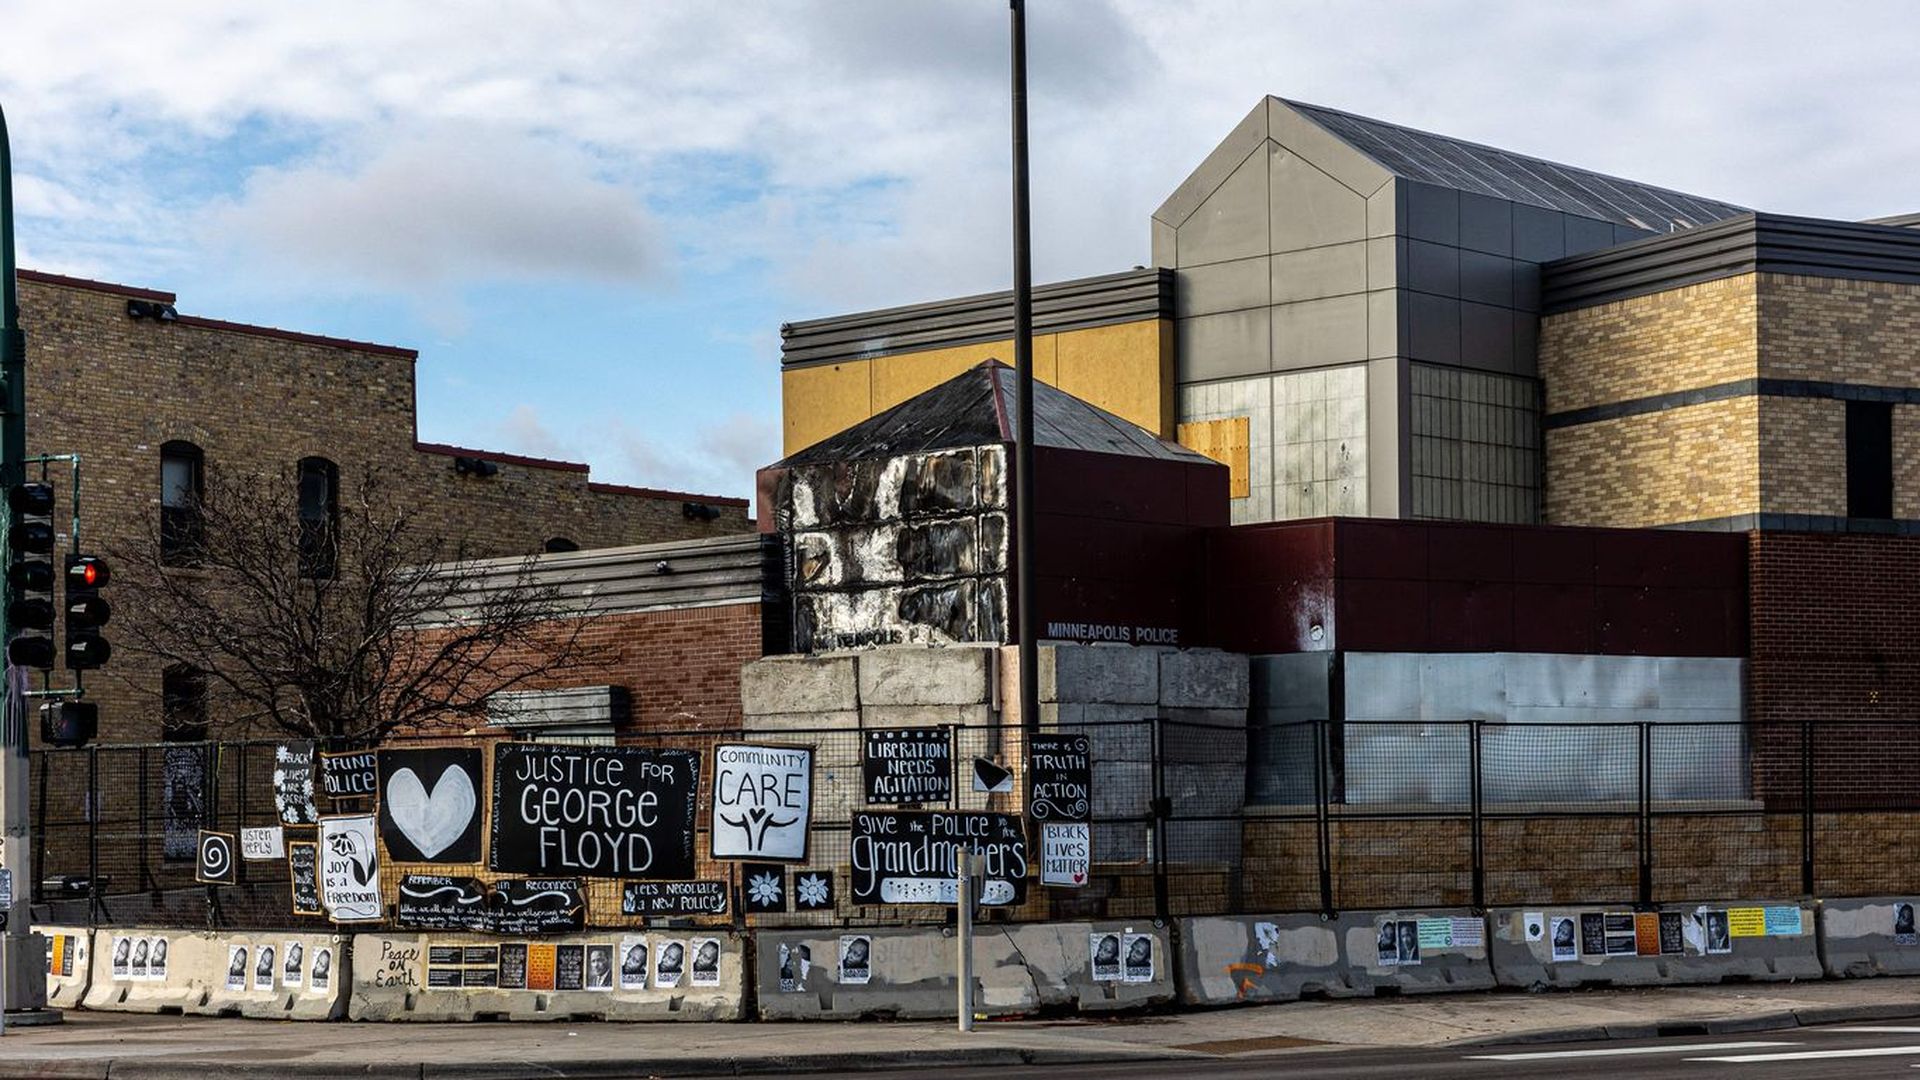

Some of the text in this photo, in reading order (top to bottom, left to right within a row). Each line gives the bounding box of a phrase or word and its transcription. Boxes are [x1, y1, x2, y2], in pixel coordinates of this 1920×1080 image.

[1048, 622, 1178, 643] MINNEAPOLIS POLICE
[1032, 755, 1086, 769] TRUTH
[641, 761, 675, 785] FOR
[719, 770, 804, 808] CARE
[1033, 783, 1087, 799] ACTION
[910, 821, 925, 833] the
[540, 826, 654, 873] FLOYD
[327, 861, 349, 873] JOY
[381, 941, 419, 961] Peace
[375, 969, 419, 987] Earth
